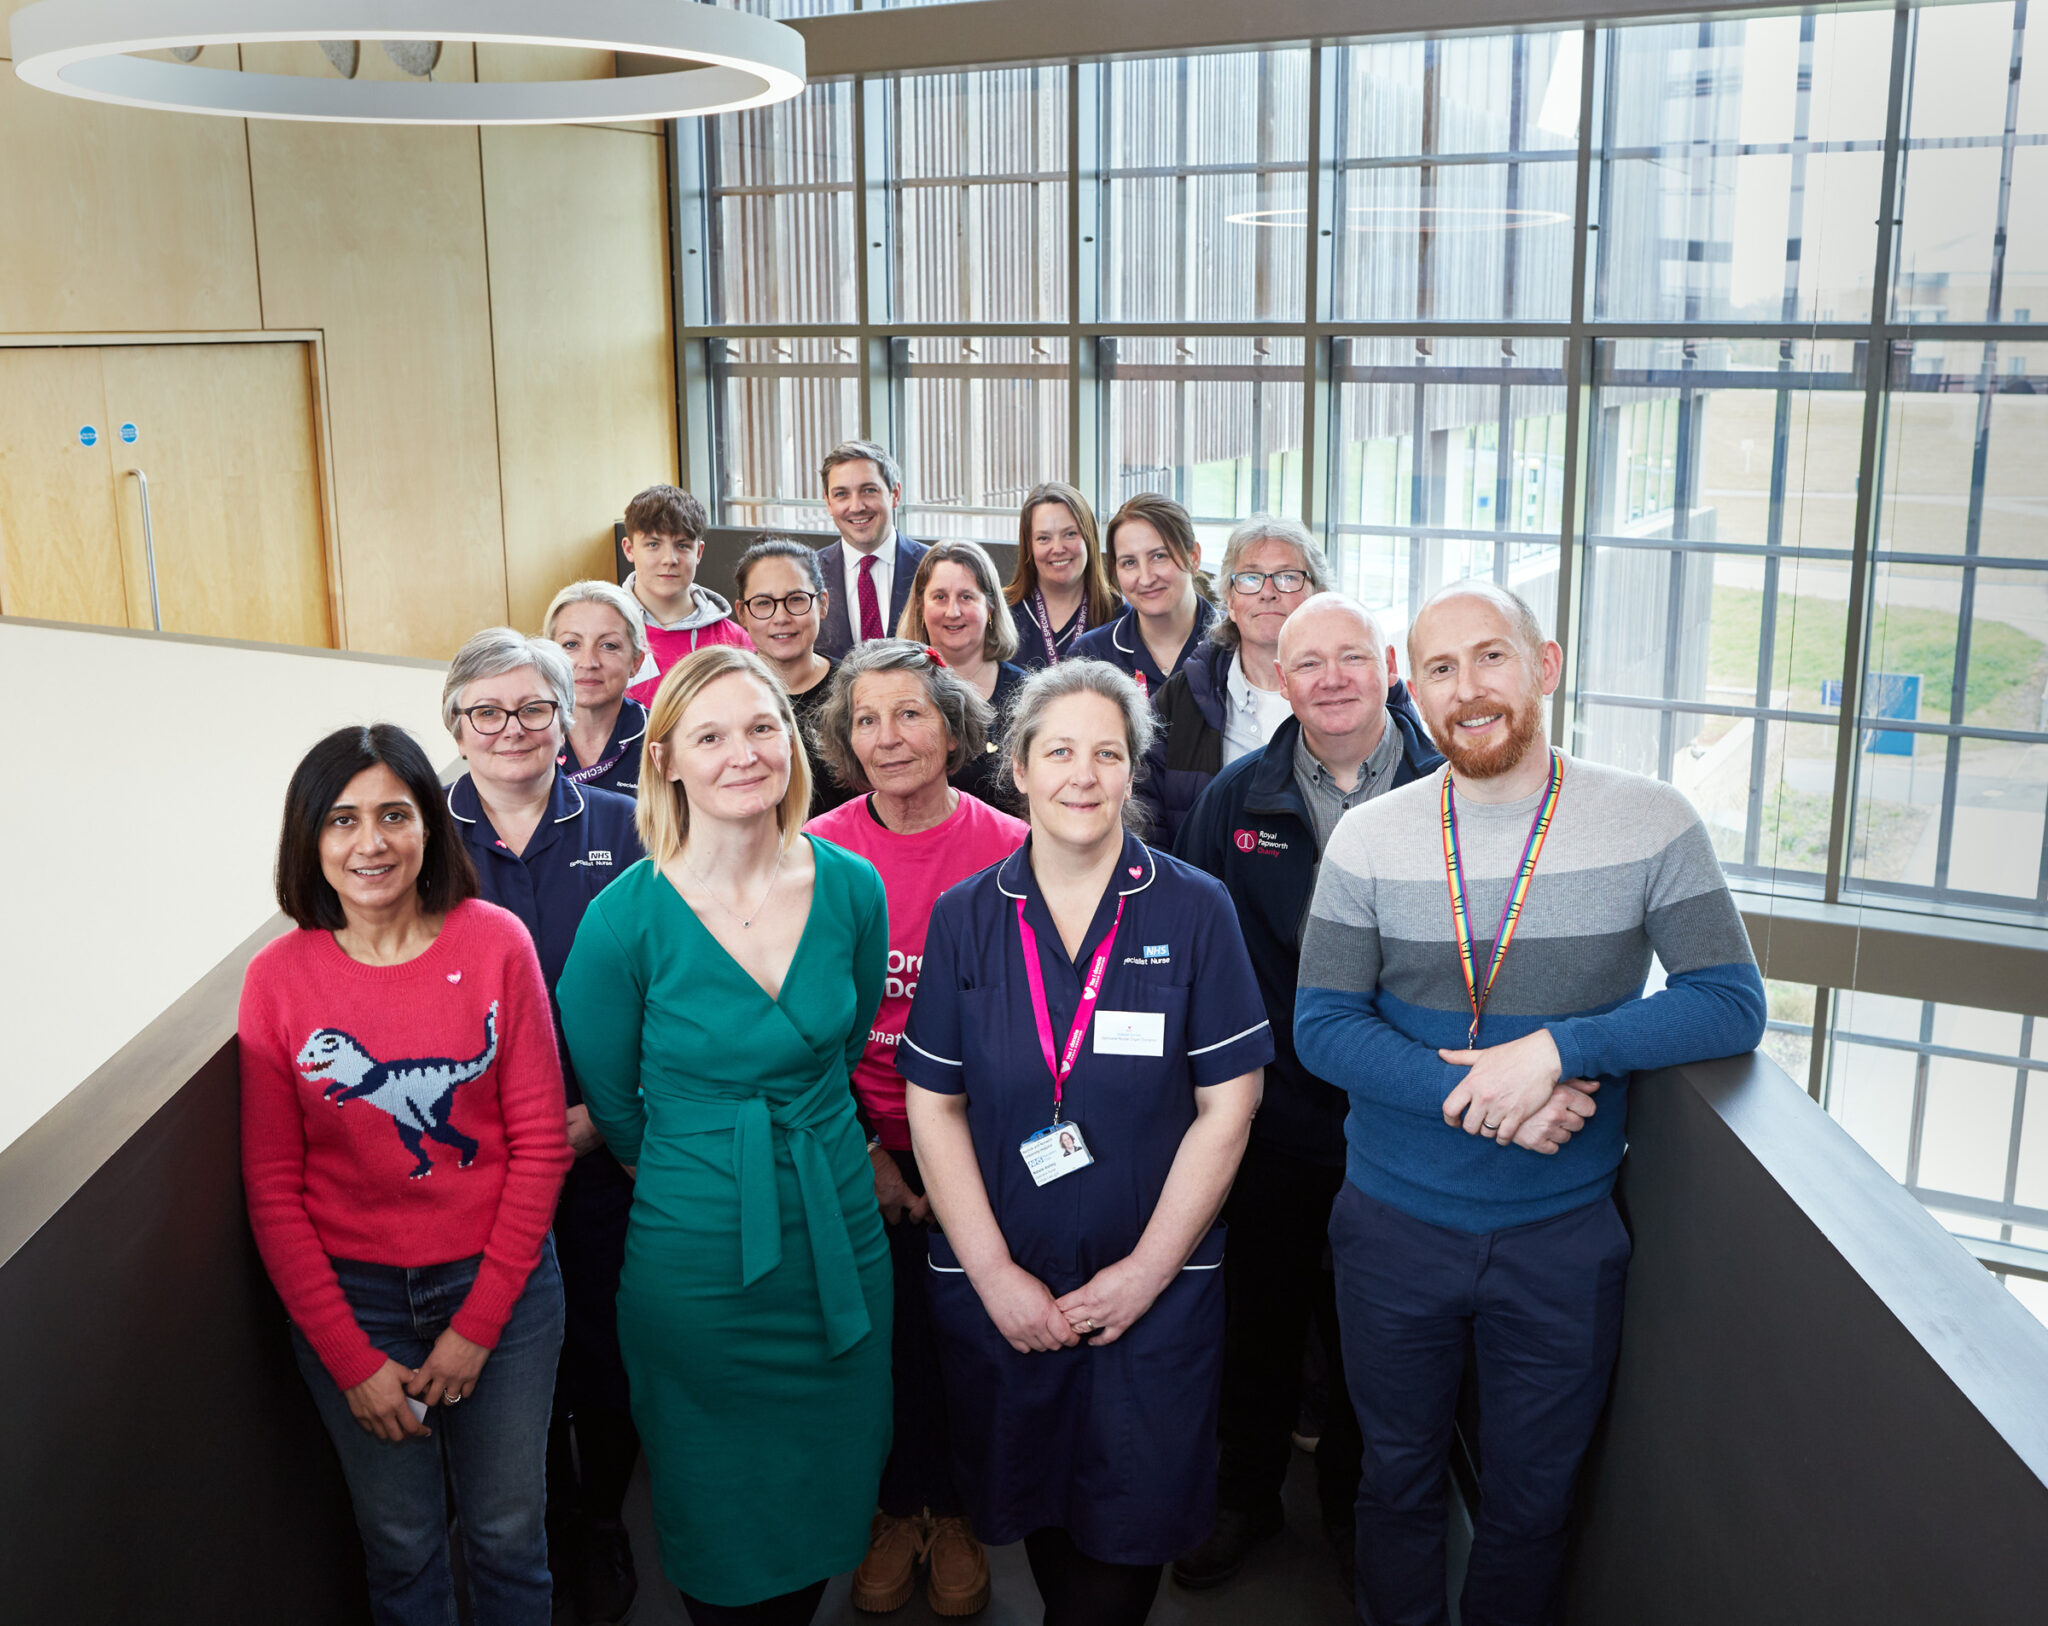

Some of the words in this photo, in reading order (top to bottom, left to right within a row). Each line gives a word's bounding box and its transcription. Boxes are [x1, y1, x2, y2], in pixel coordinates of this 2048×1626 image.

[1036, 602, 1050, 636] SPECIALIST
[1080, 606, 1088, 624] CARE
[1046, 638, 1056, 656] CARE
[1258, 830, 1278, 840] Royal
[1258, 838, 1288, 850] Papworth
[590, 852, 610, 860] NHS
[1256, 846, 1280, 858] Charity
[1146, 945, 1167, 956] NHS
[1092, 956, 1102, 974] donate
[1070, 1028, 1080, 1048] donate
